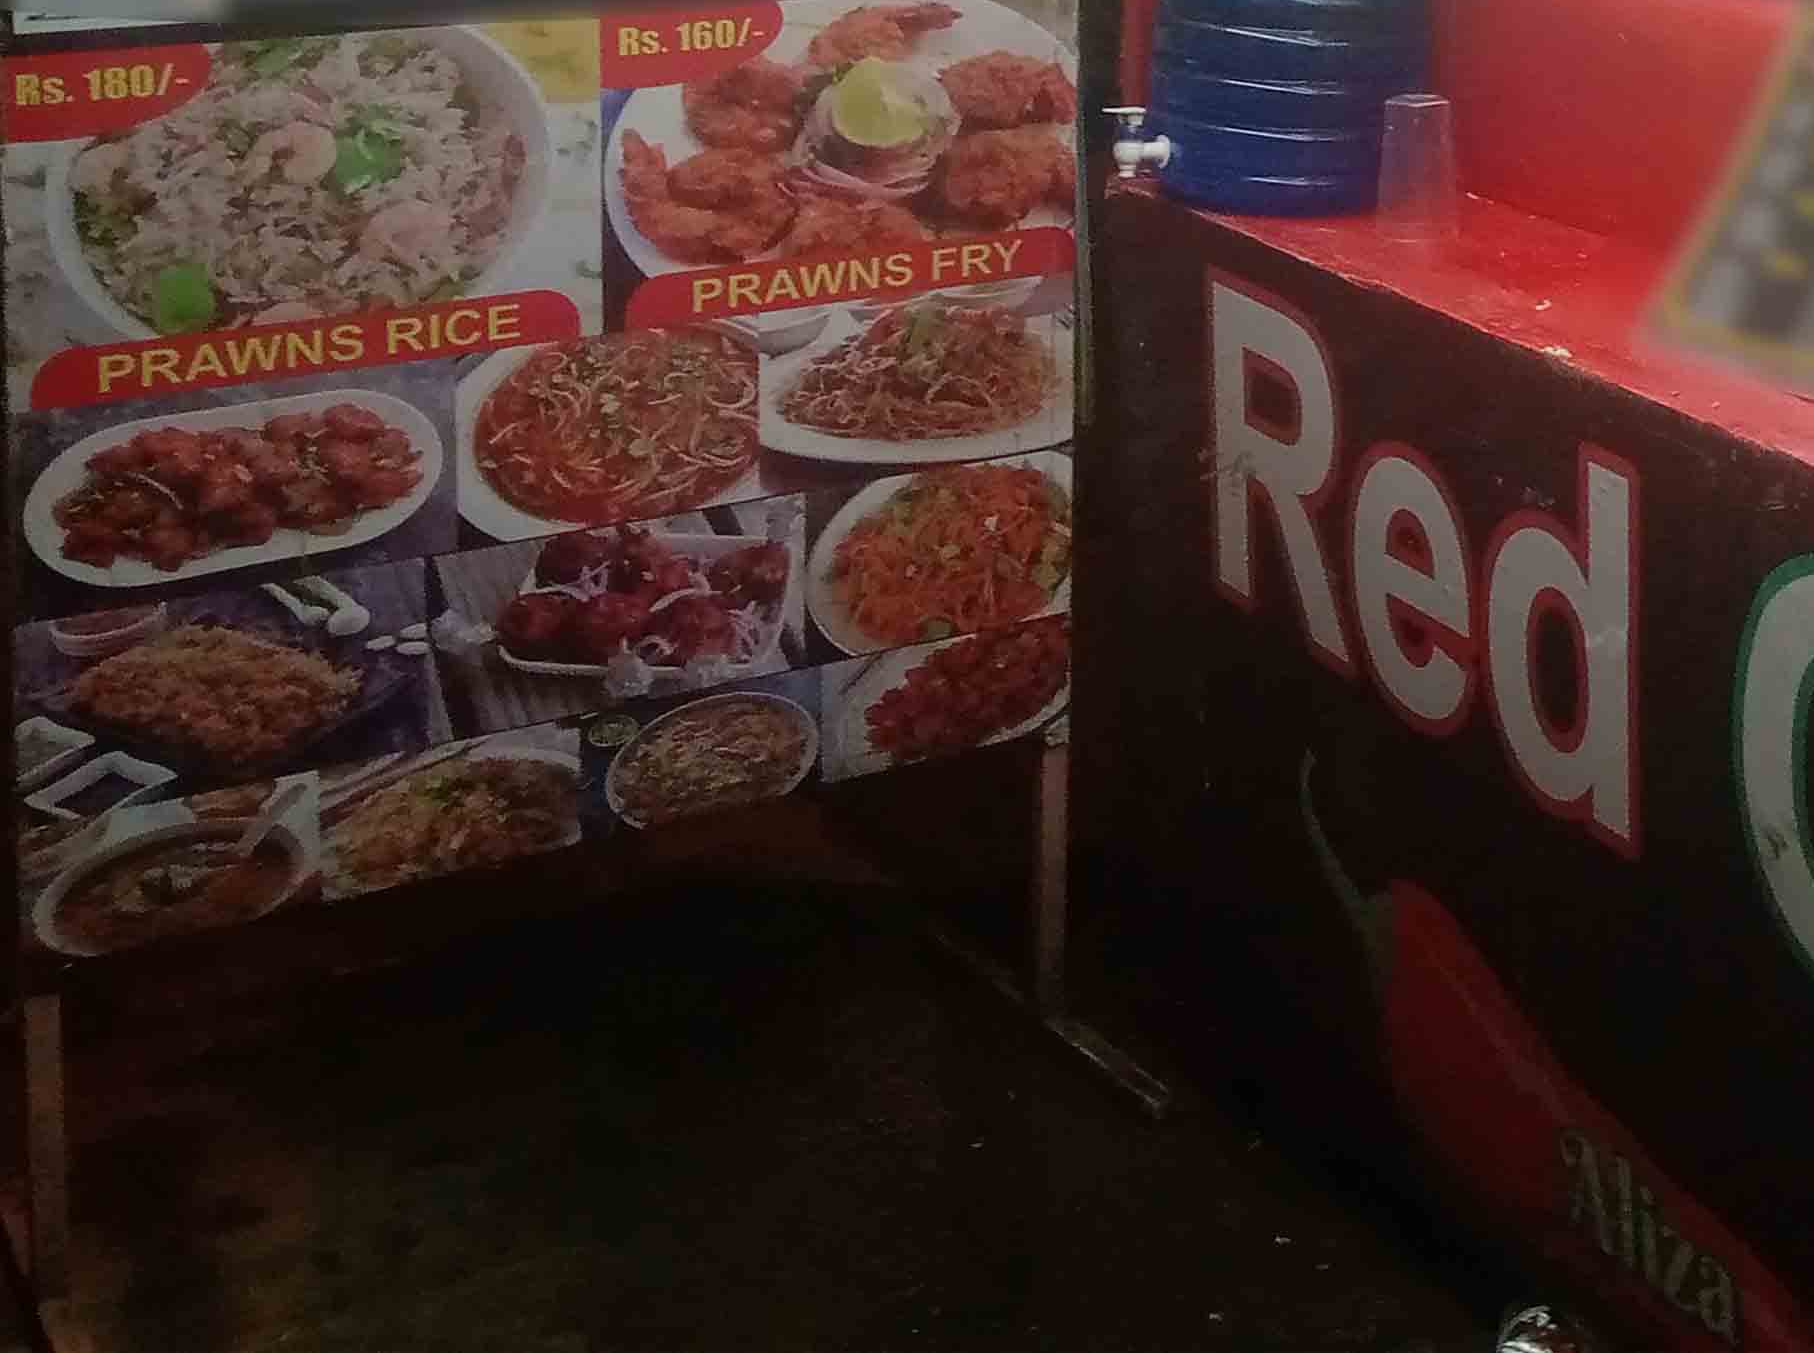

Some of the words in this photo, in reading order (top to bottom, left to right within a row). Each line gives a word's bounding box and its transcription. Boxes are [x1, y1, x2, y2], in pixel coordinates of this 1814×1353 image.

[618, 26, 669, 56] Rs.
[676, 16, 765, 52] 160/-
[15, 73, 75, 106] Rs.
[83, 62, 190, 101] 180/-
[691, 252, 914, 315] PRAWNS
[930, 239, 1023, 282] FRY
[96, 325, 367, 394] PRAWNS
[385, 303, 523, 356] RICE
[1206, 262, 1641, 859] Red
